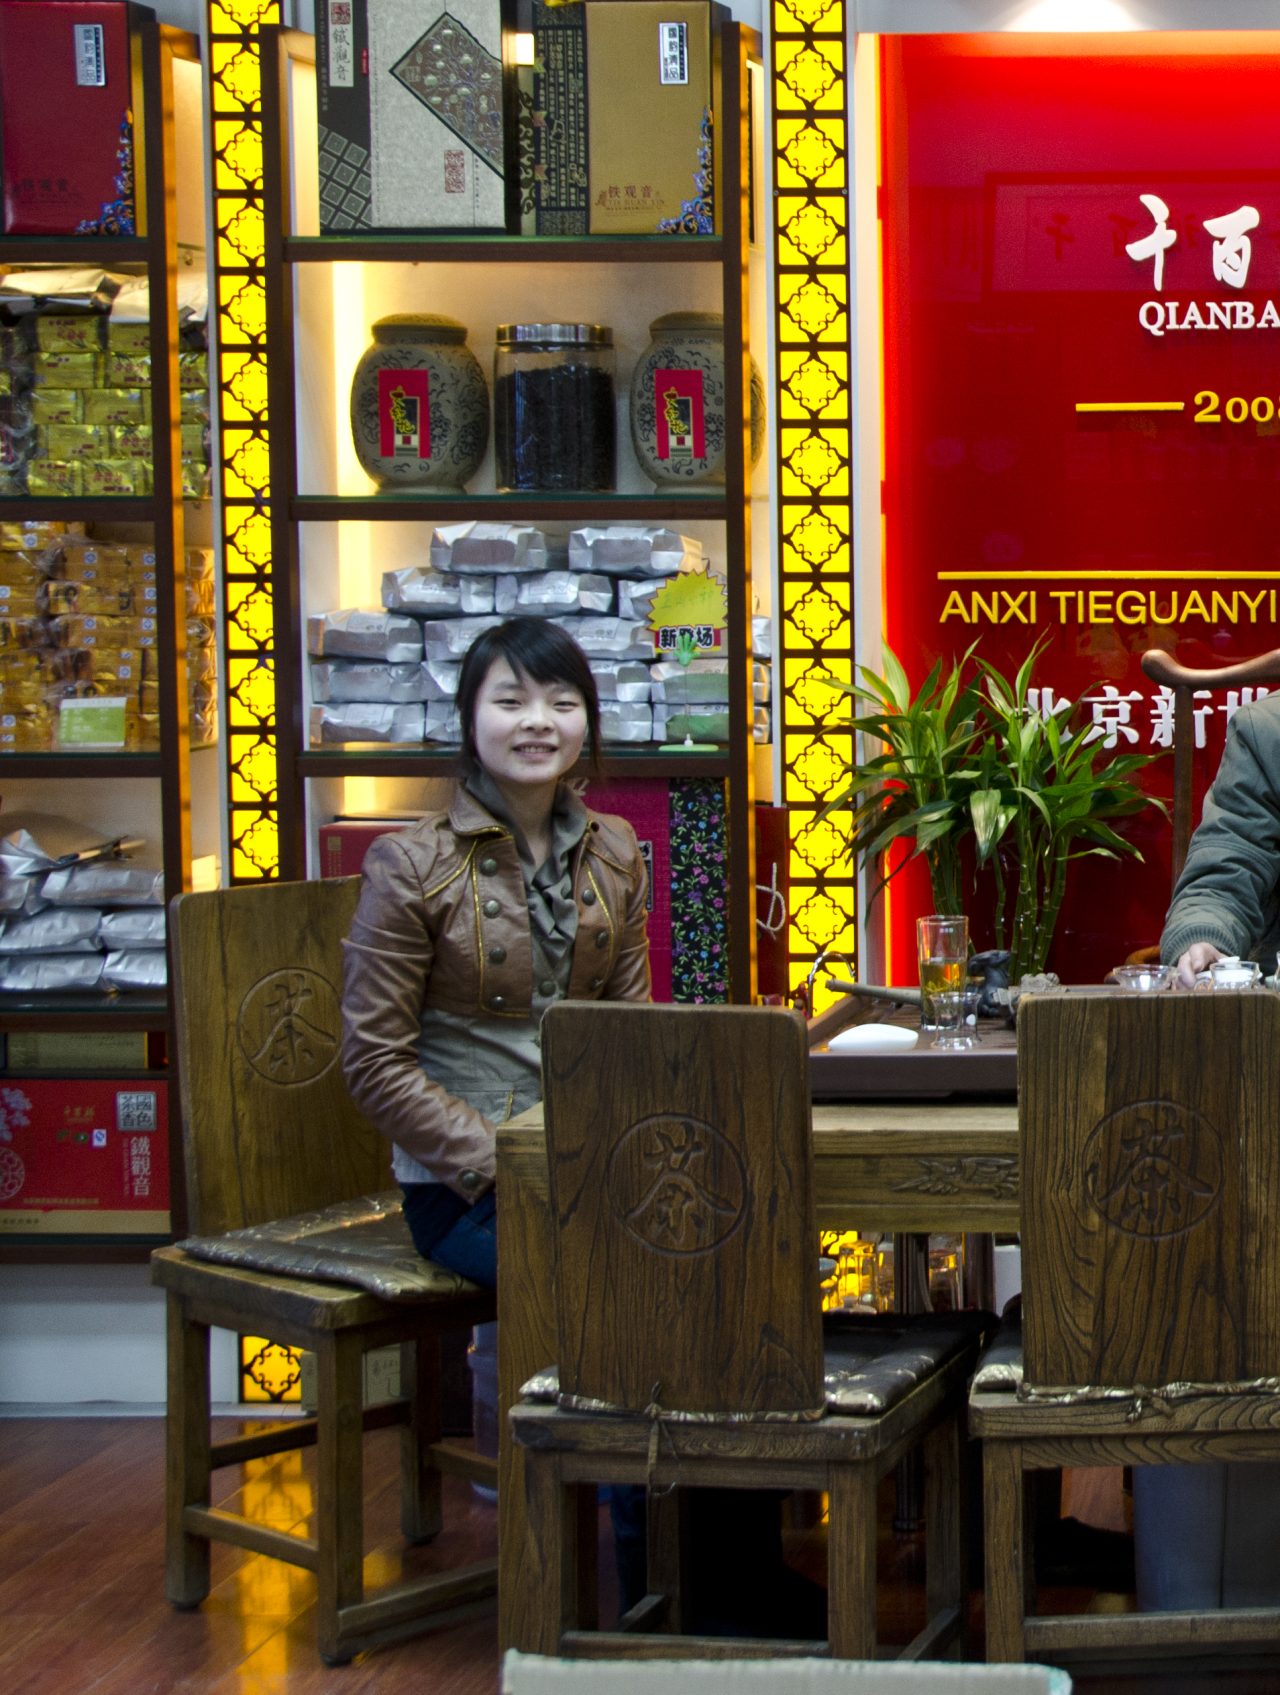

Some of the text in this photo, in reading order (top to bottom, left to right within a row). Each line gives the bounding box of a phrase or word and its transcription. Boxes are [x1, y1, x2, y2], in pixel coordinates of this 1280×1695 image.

[607, 185, 653, 199] 铁观音
[939, 590, 1038, 625] ANXI
[130, 1135, 152, 1197] 鐵觀音
